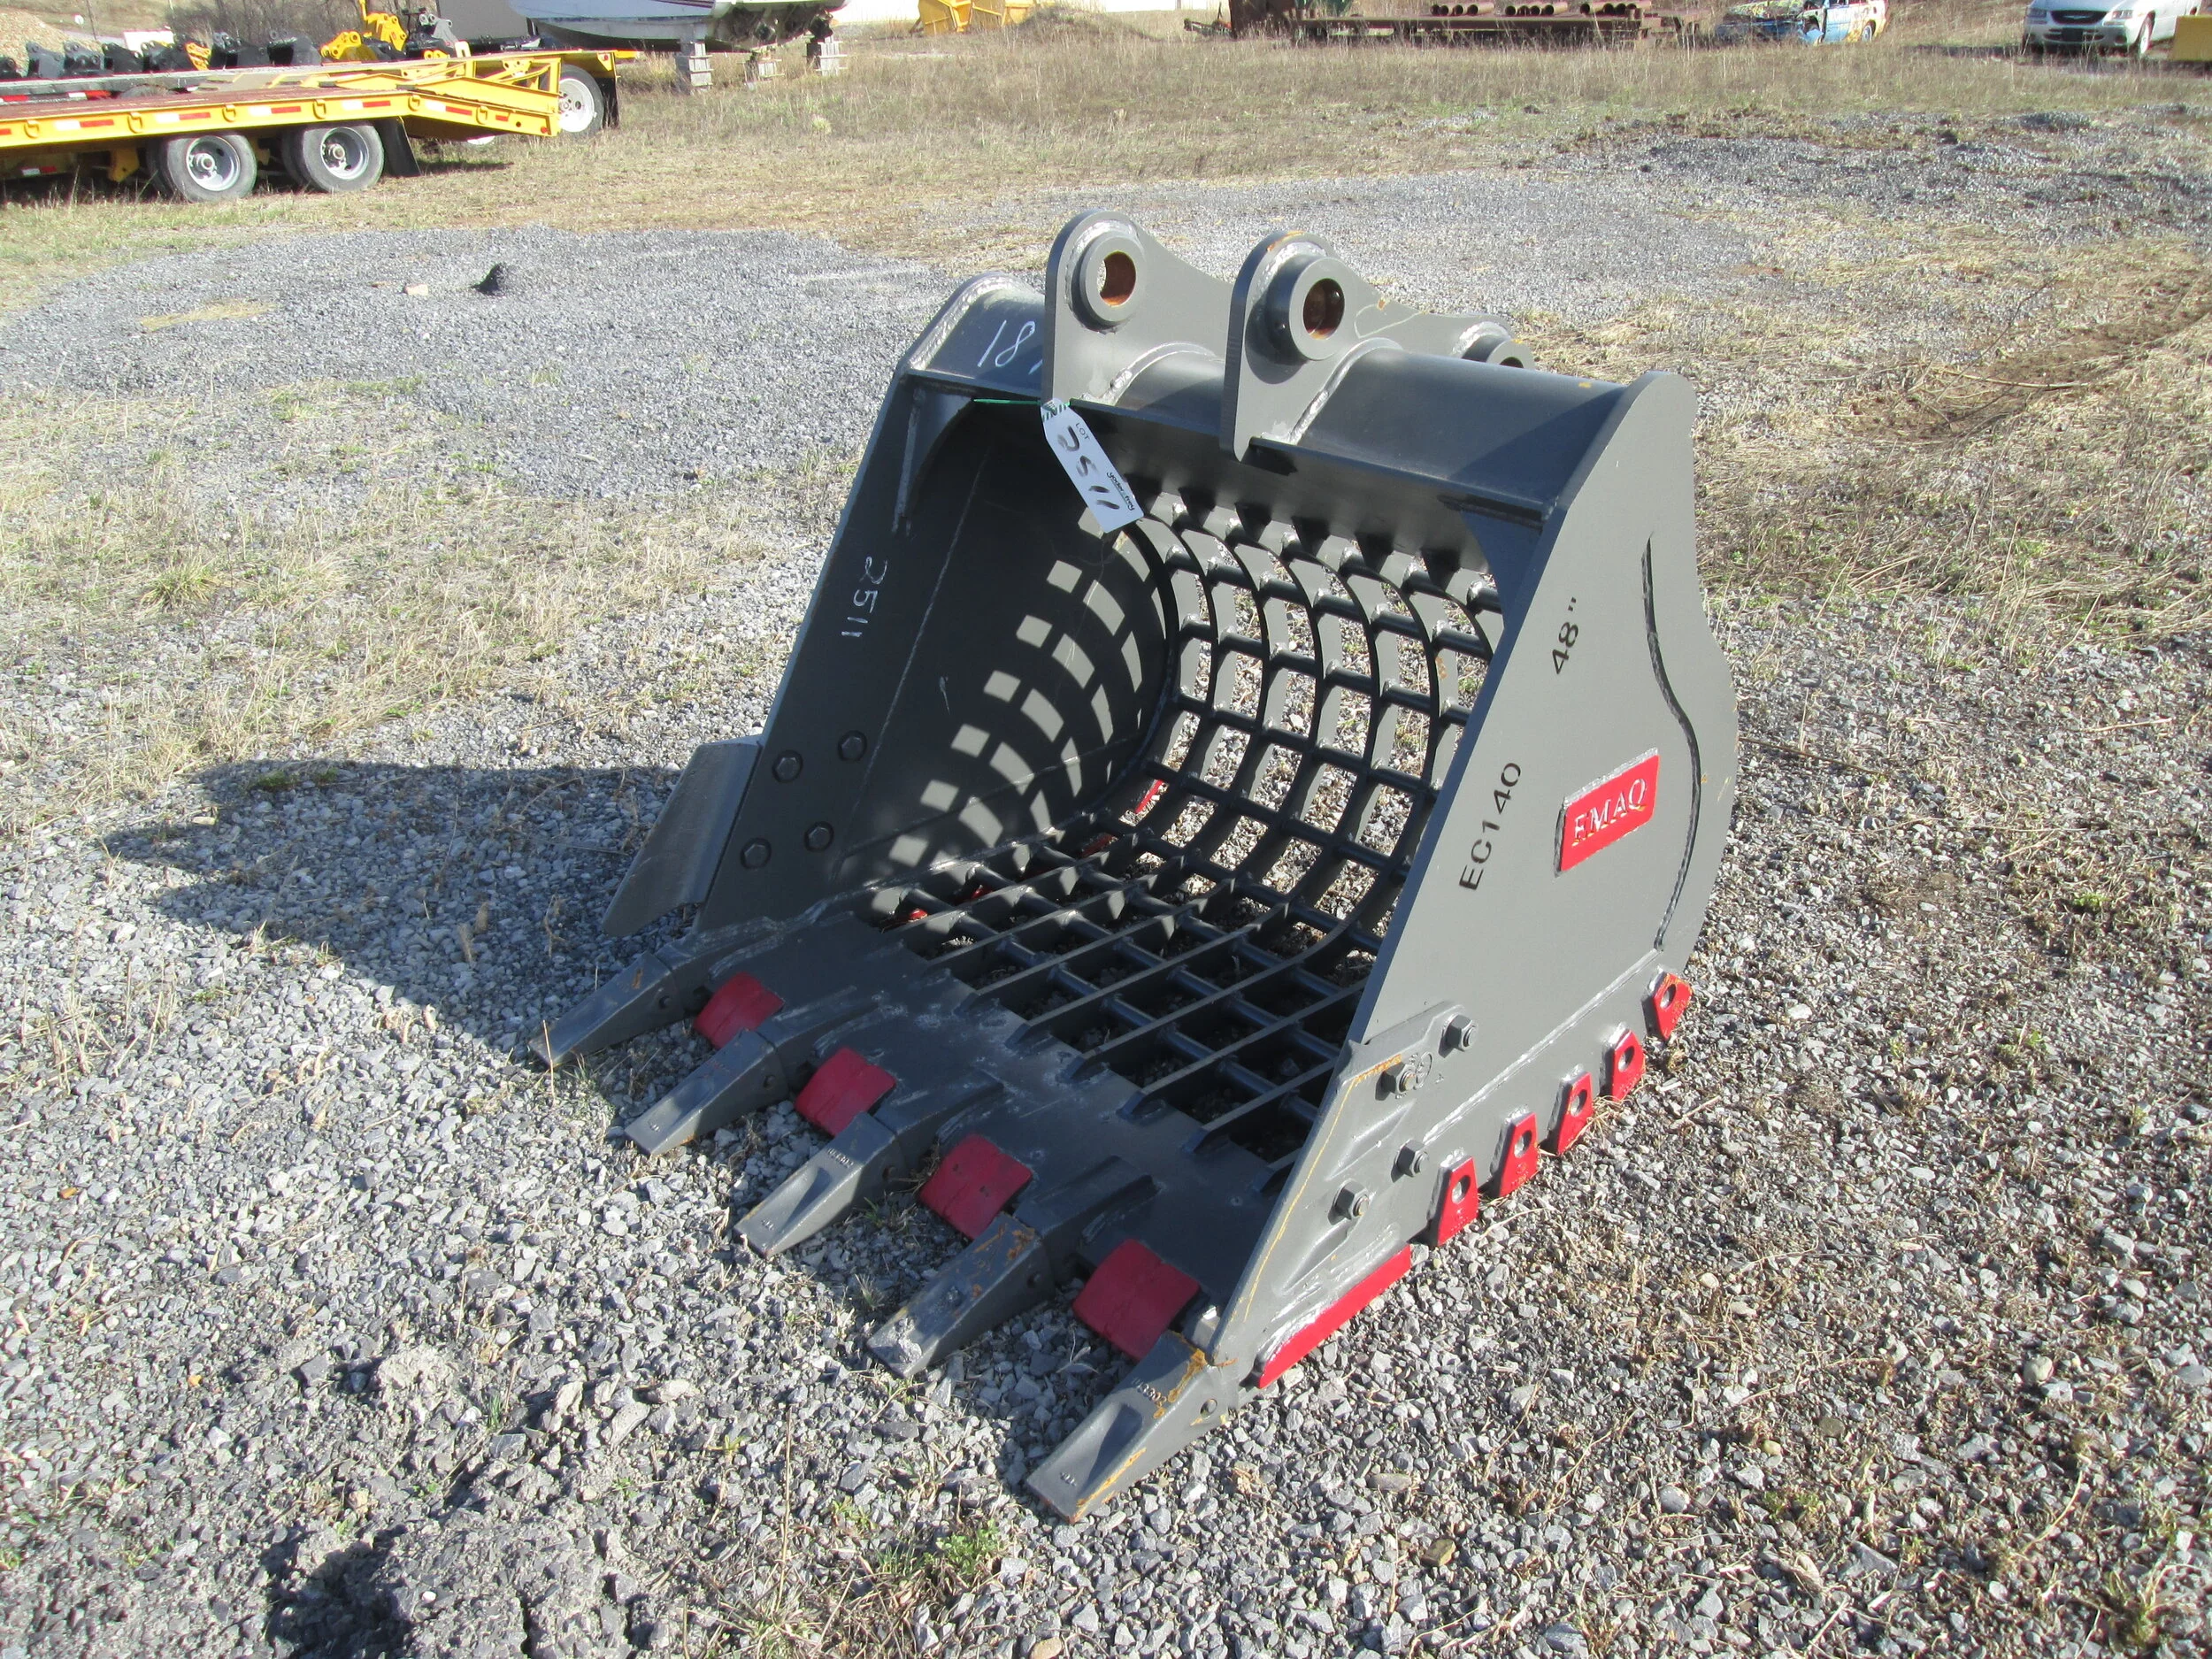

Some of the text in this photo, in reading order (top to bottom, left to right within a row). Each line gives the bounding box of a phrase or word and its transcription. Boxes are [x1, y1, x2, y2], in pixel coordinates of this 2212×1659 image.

[1057, 425, 1120, 511] 2511
[1075, 422, 1090, 440] LOT
[841, 556, 888, 637] 2511
[1552, 596, 1579, 674] 48"
[1459, 762, 1522, 890] EC140
